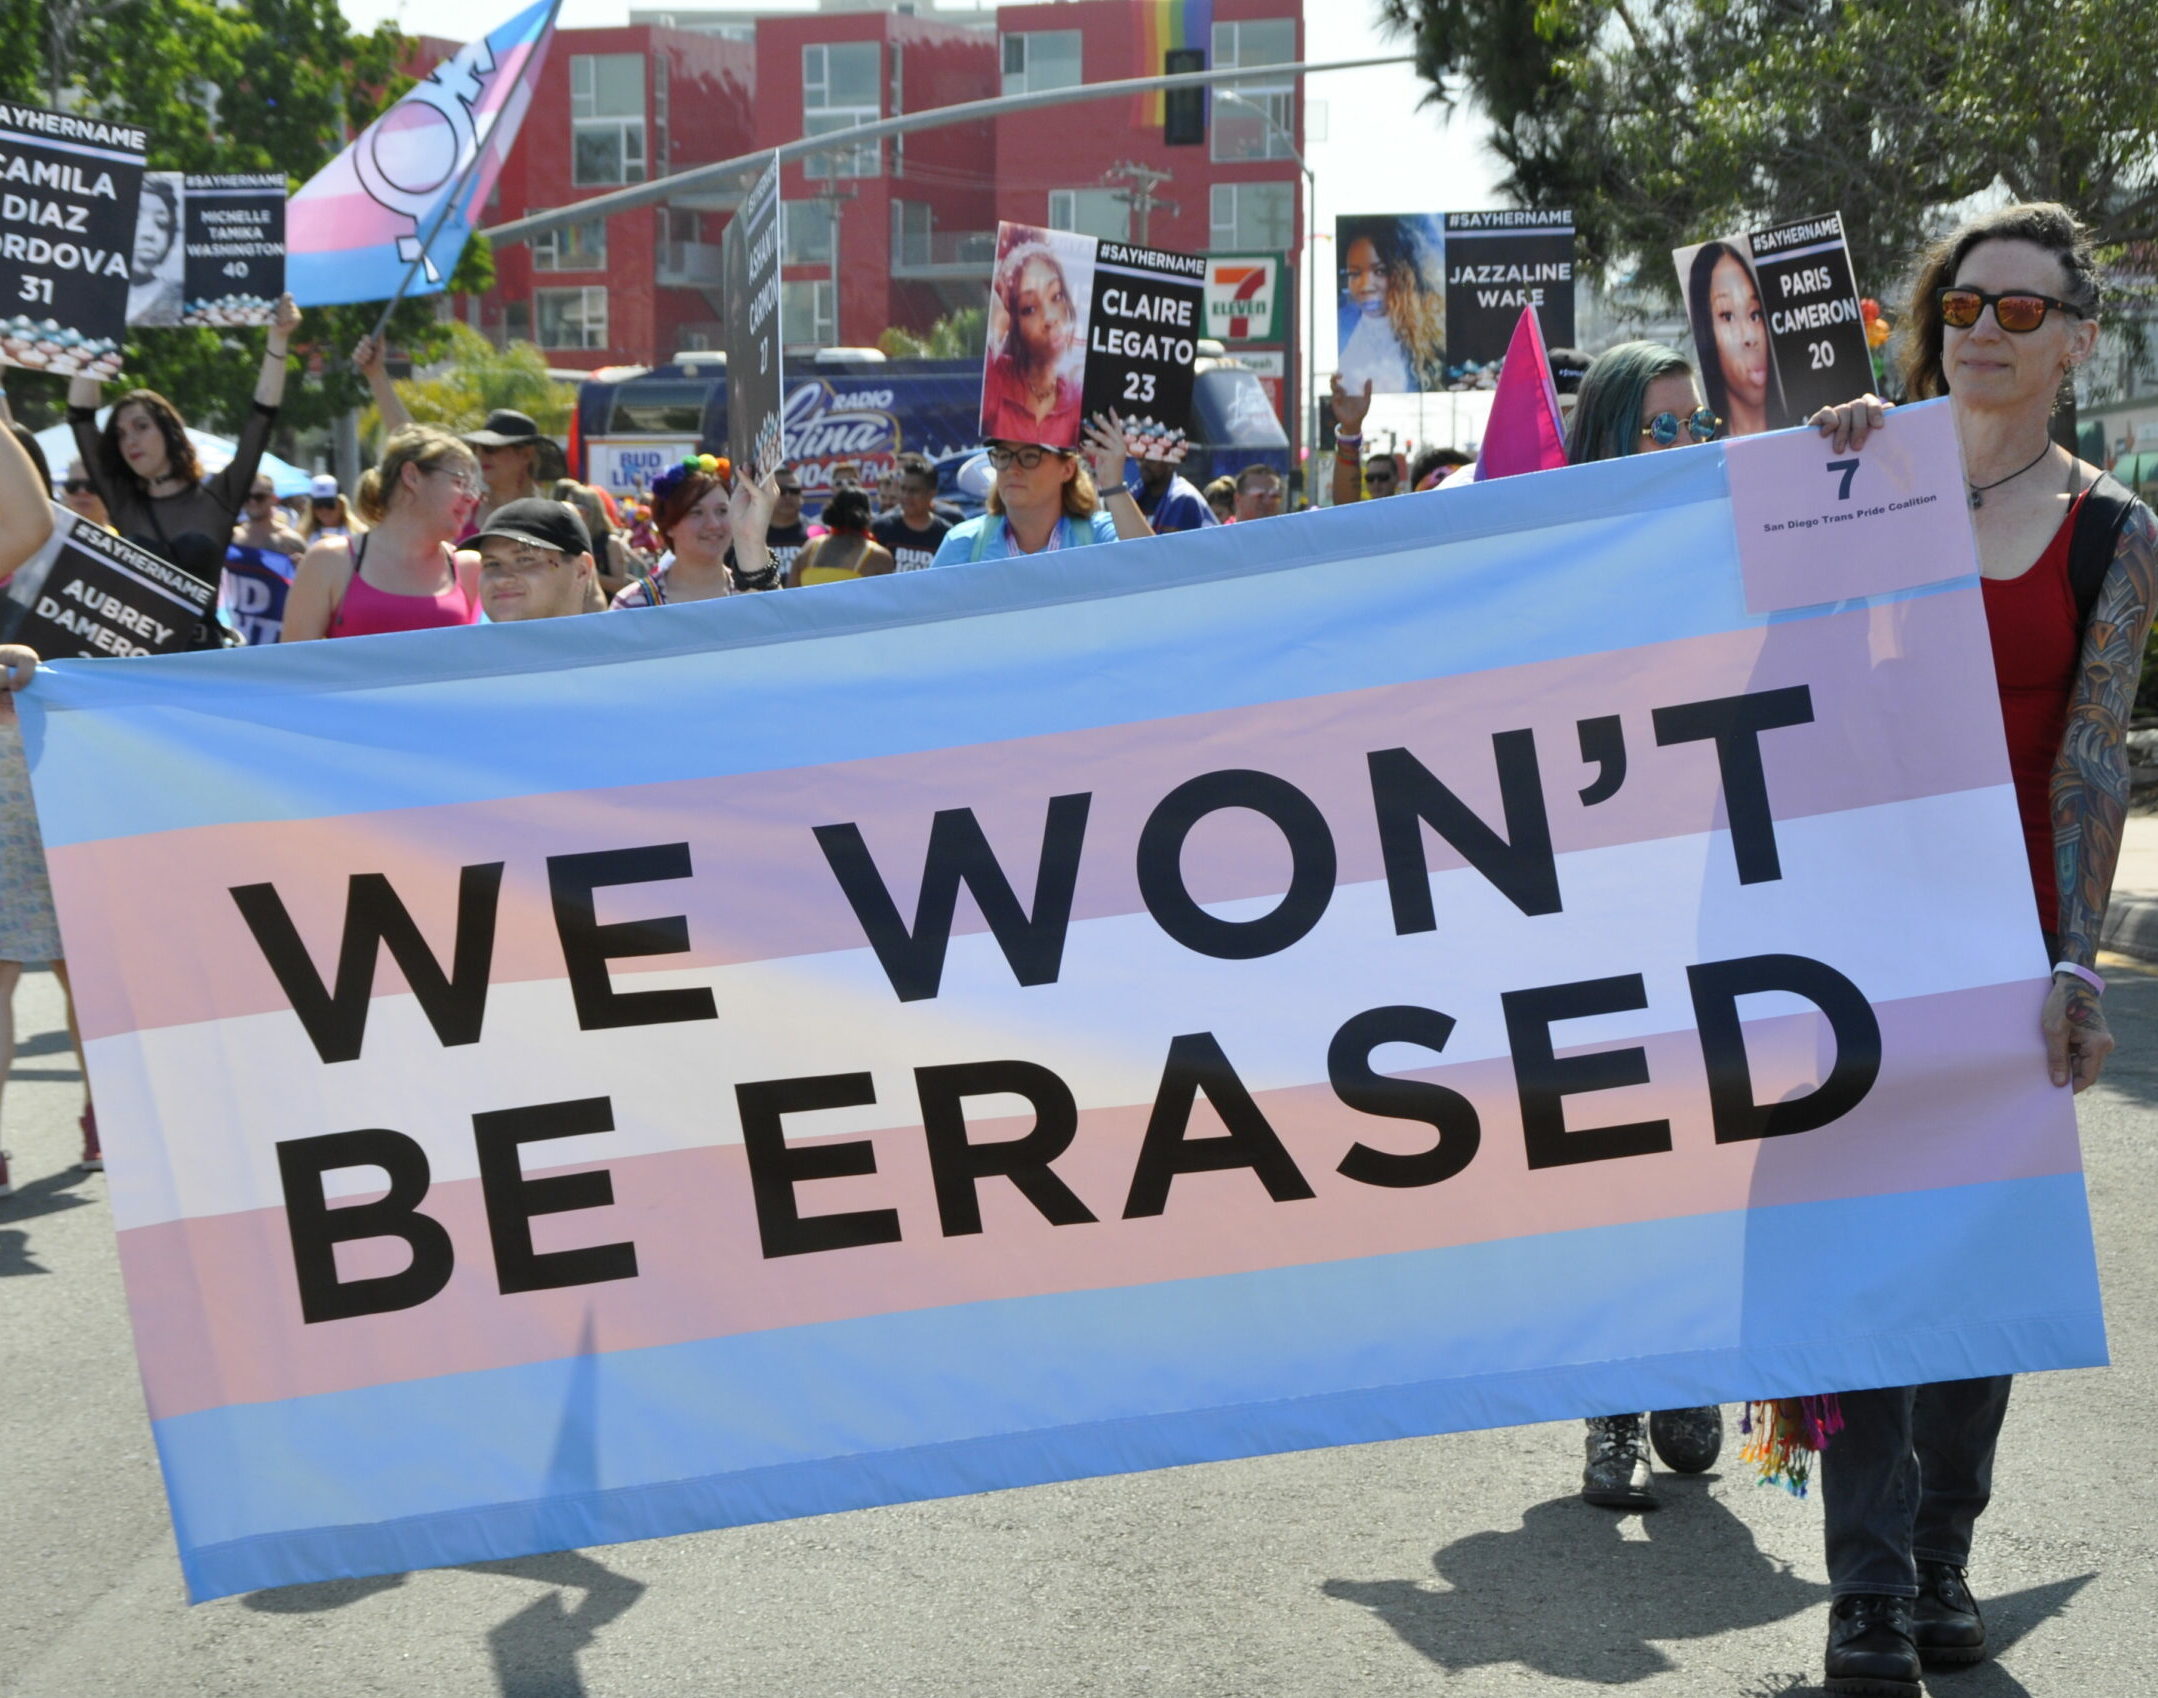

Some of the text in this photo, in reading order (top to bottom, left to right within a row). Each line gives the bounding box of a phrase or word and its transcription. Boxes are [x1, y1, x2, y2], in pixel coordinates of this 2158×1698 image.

[2, 192, 90, 234] DIAZ
[201, 209, 271, 225] MICHELLE
[1450, 210, 1572, 228] #SAYHERNAME
[186, 242, 285, 257] WASHINGTON
[1753, 217, 1840, 252] #SAYHERNAME
[0, 232, 129, 280] RDOVA
[222, 261, 249, 278] 40
[1101, 244, 1205, 275] #SAYHERNAME
[1449, 263, 1571, 284] JAZZALINE
[18, 274, 54, 305] 31
[1780, 266, 1832, 298] PARIS
[1102, 289, 1193, 327] CLAIRE
[1214, 265, 1266, 338] 7
[1771, 297, 1858, 335] CAMERON
[1092, 326, 1193, 365] LEGATO
[1808, 340, 1835, 370] 20
[832, 389, 893, 410] RADIO
[1123, 372, 1156, 402] 23
[620, 452, 661, 468] BUD
[1825, 458, 1860, 500] 7
[1763, 494, 1938, 533] San Diego Trans Pride Coalition
[74, 522, 212, 606] #SAYHERNAME
[62, 579, 174, 645] AUBREY
[228, 684, 1815, 1064] WE WON'T
[275, 953, 1883, 1325] BE ERASED
